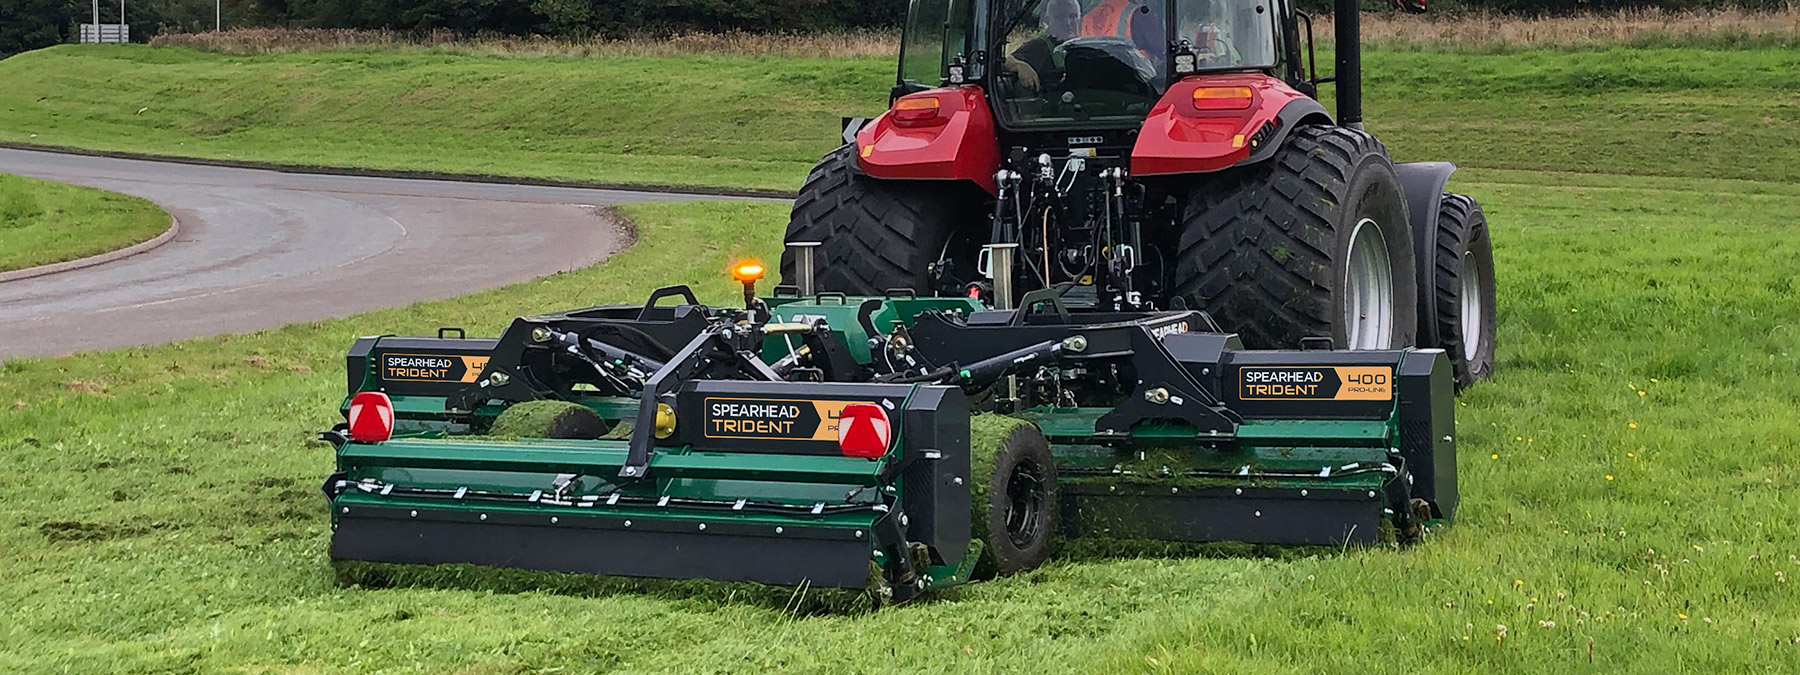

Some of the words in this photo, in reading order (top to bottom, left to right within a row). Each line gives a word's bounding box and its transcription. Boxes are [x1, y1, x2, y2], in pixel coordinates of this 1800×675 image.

[388, 357, 452, 368] SPEARHEAD
[388, 367, 448, 378] TRIDENT
[1246, 371, 1324, 383] SPEARHEAD
[1347, 374, 1386, 385] 400
[1246, 384, 1319, 396] TRIDENT
[712, 404, 801, 418] SPEARHEAD
[712, 419, 794, 434] TRIDENT
